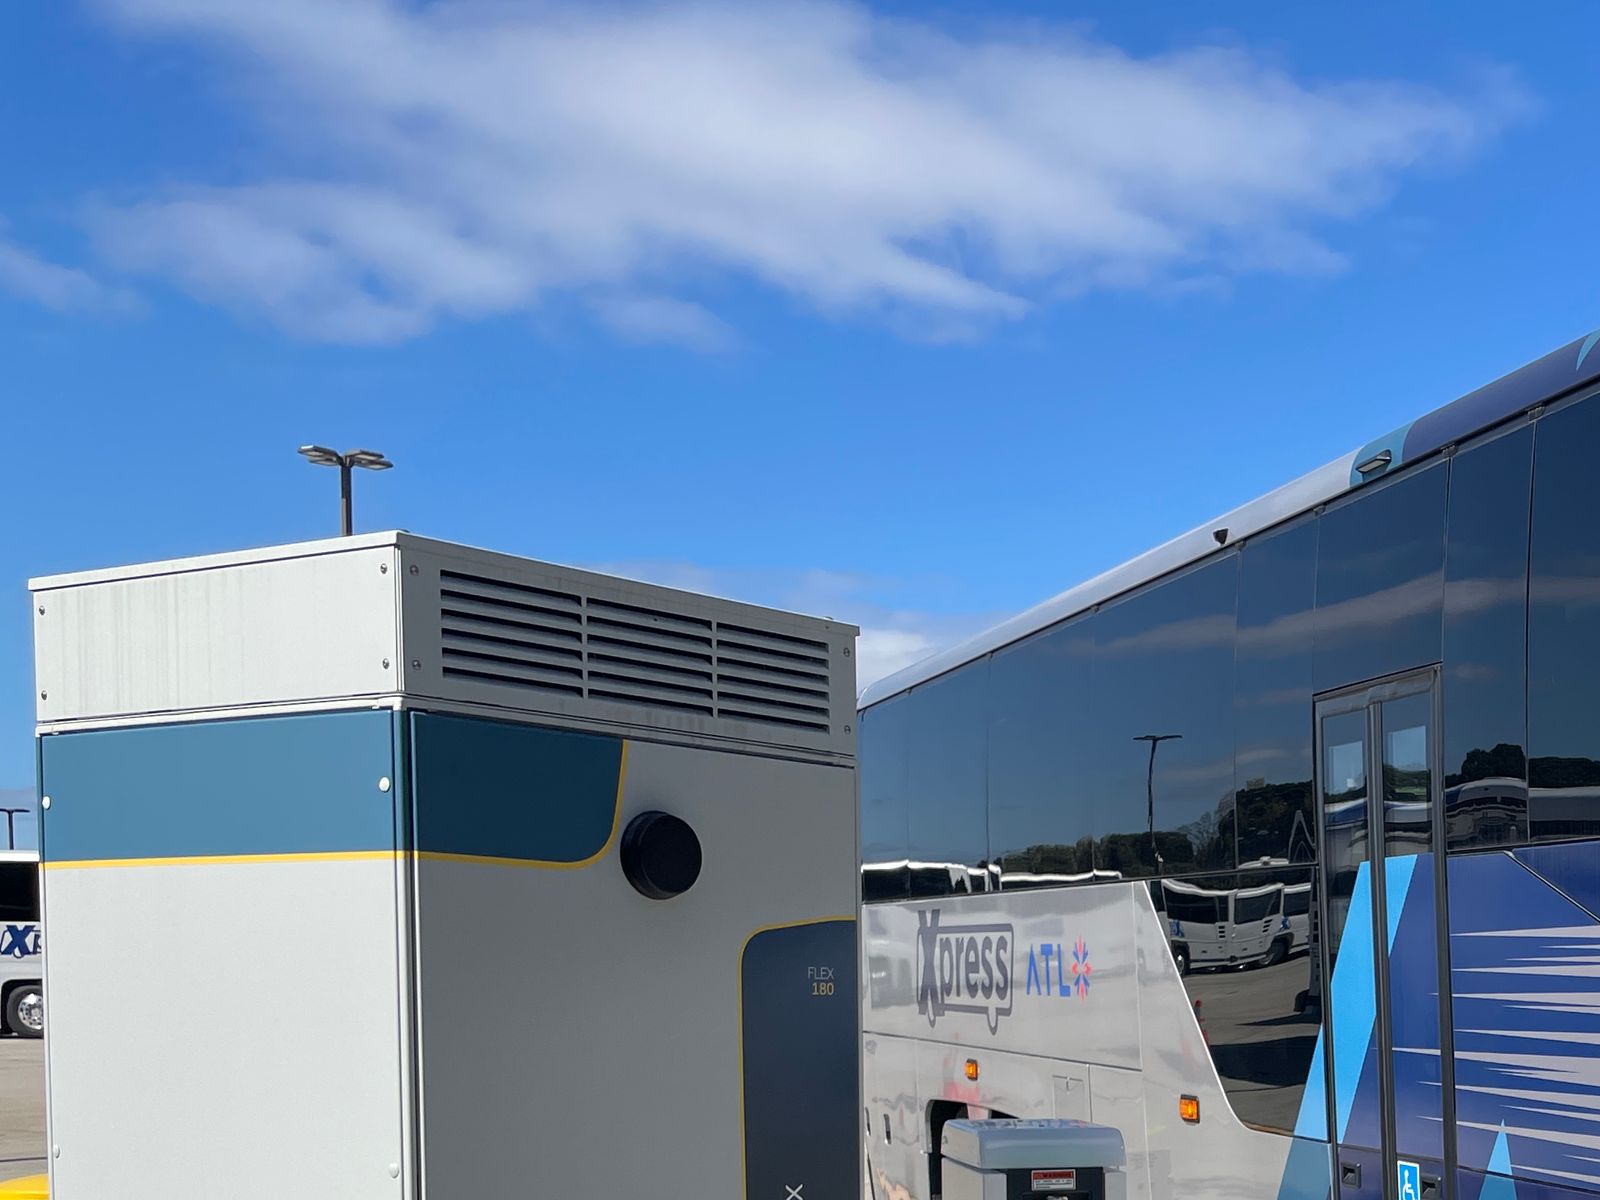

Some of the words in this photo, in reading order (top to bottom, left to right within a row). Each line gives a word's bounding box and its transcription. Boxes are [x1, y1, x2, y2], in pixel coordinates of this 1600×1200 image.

[807, 966, 834, 980] FLEX
[917, 908, 1009, 1016] Xpress
[1026, 943, 1071, 997] ATL
[811, 982, 835, 996] 180
